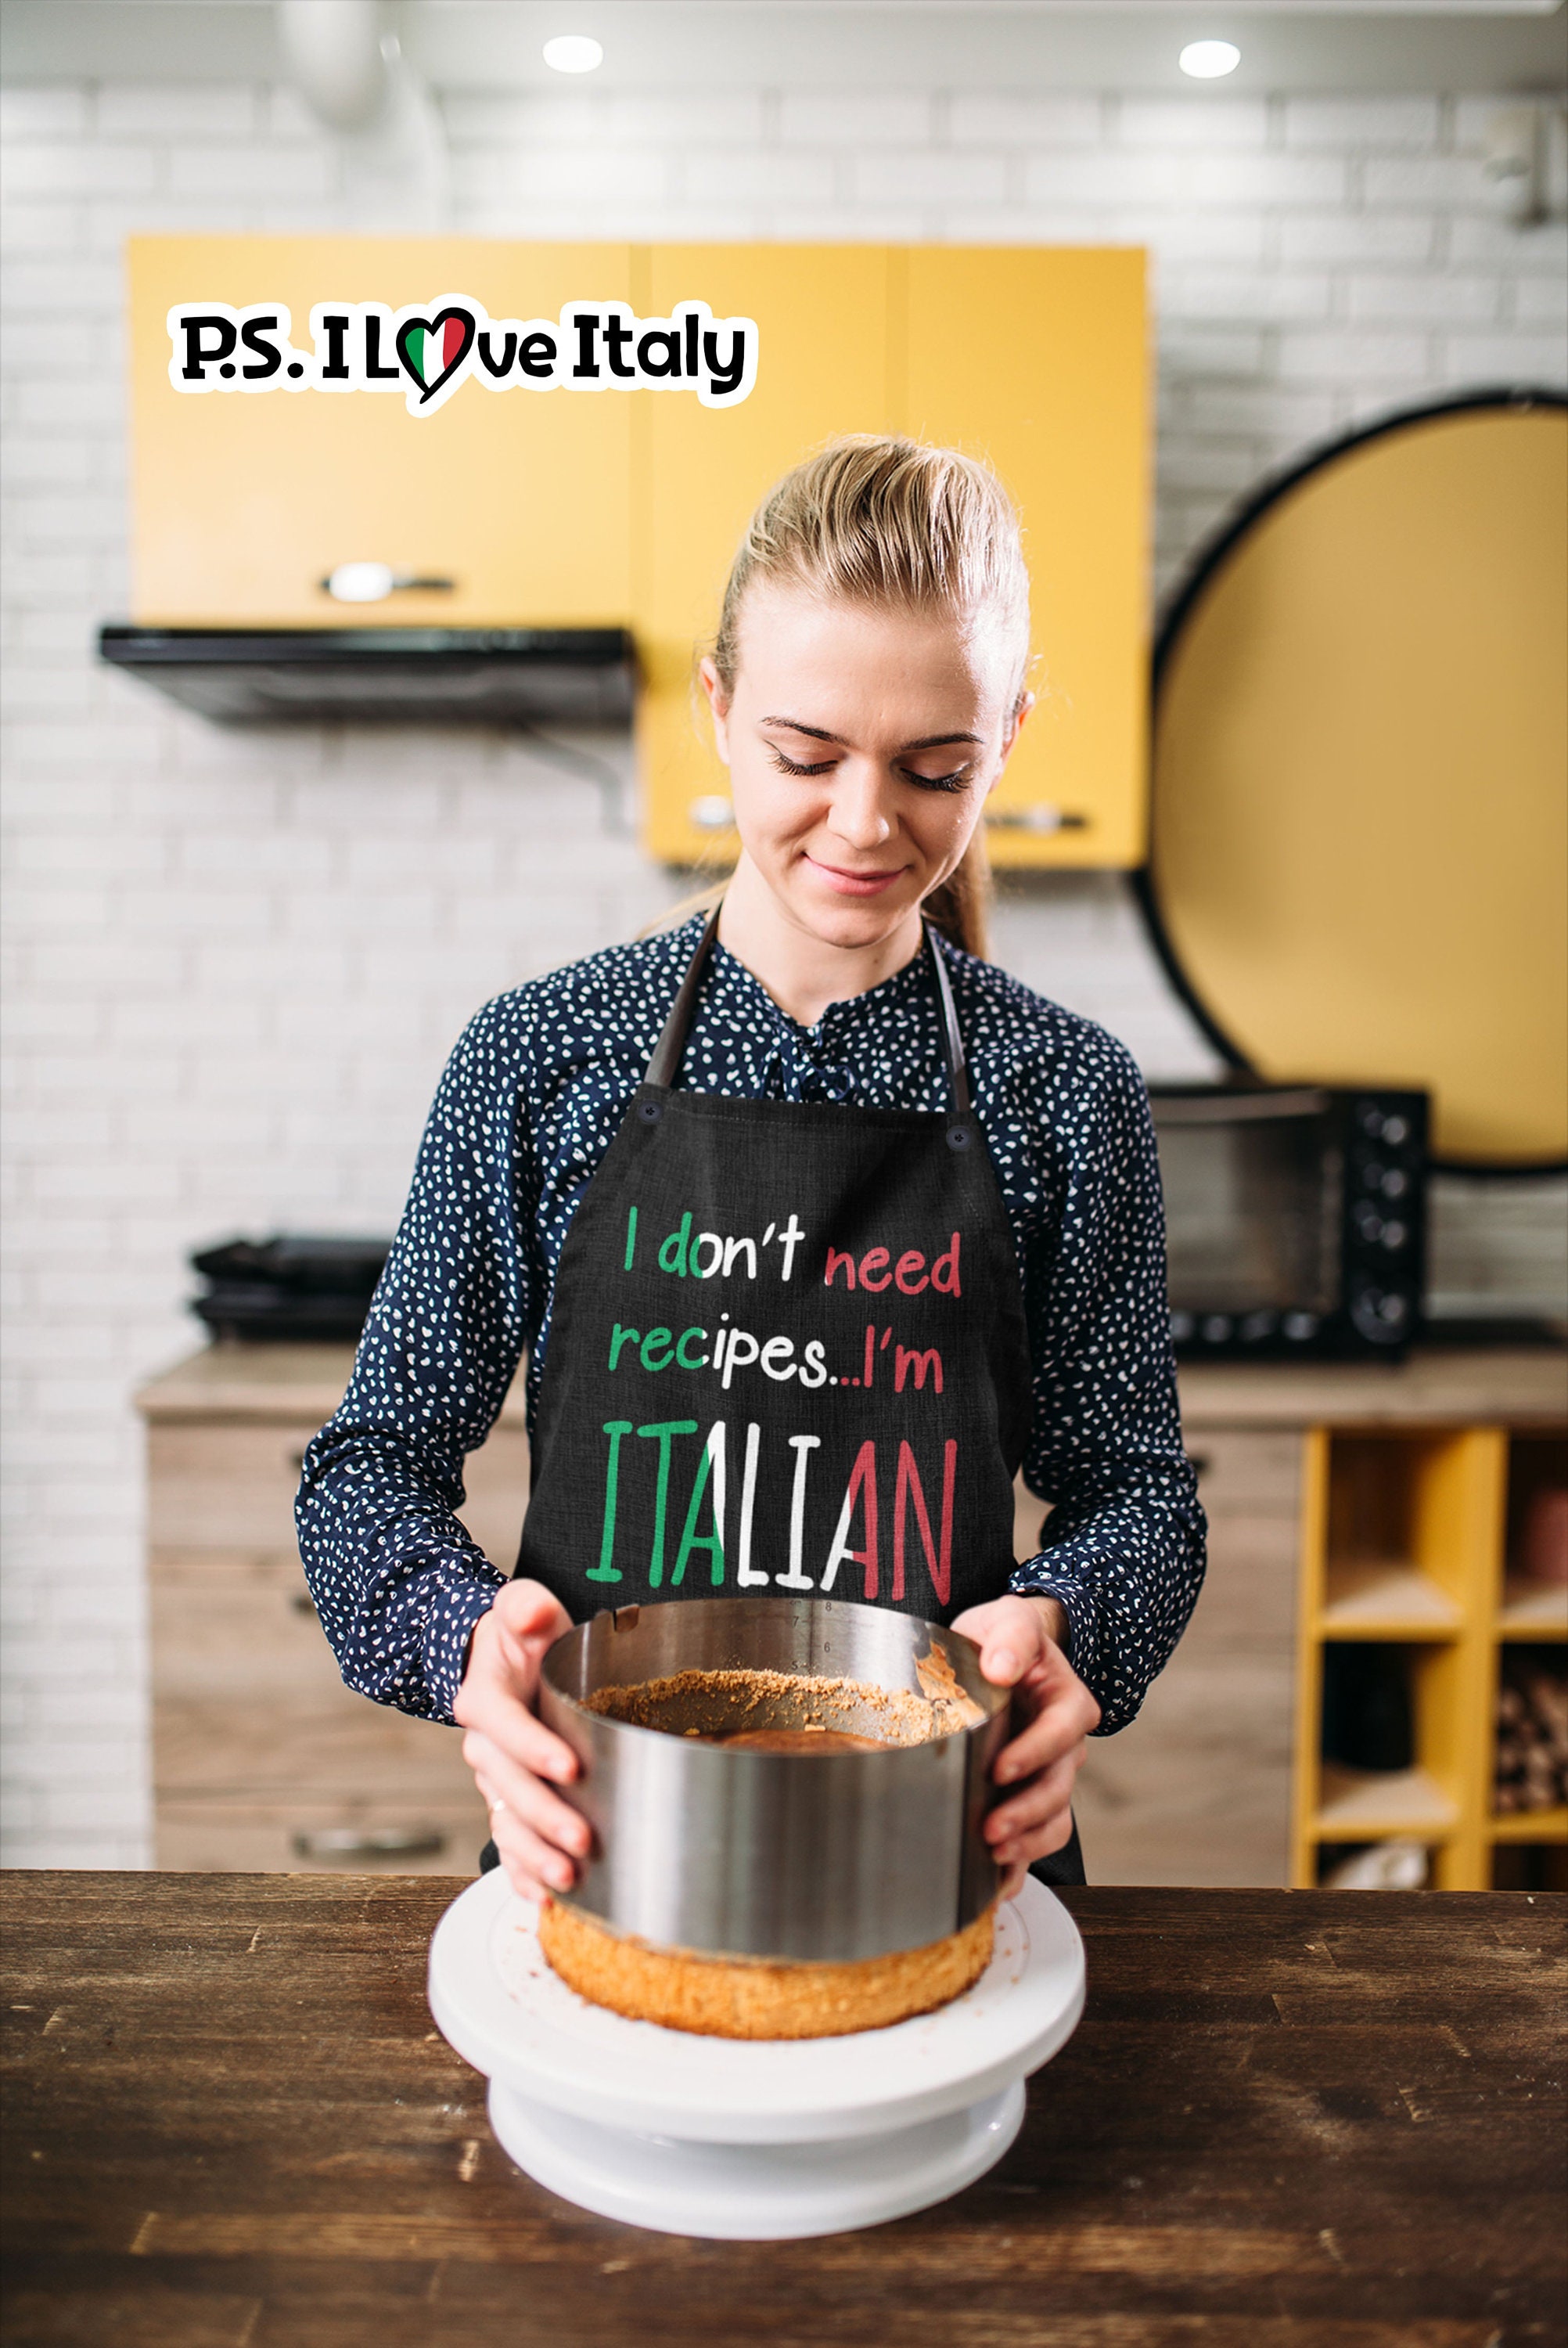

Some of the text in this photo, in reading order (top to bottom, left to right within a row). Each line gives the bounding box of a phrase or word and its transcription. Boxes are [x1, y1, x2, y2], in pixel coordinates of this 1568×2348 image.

[624, 1206, 961, 1298] I don't need
[586, 1420, 957, 1606] ITALIAN
[825, 1601, 832, 1612] 8
[793, 1615, 799, 1627] 7
[824, 1641, 830, 1653] 6
